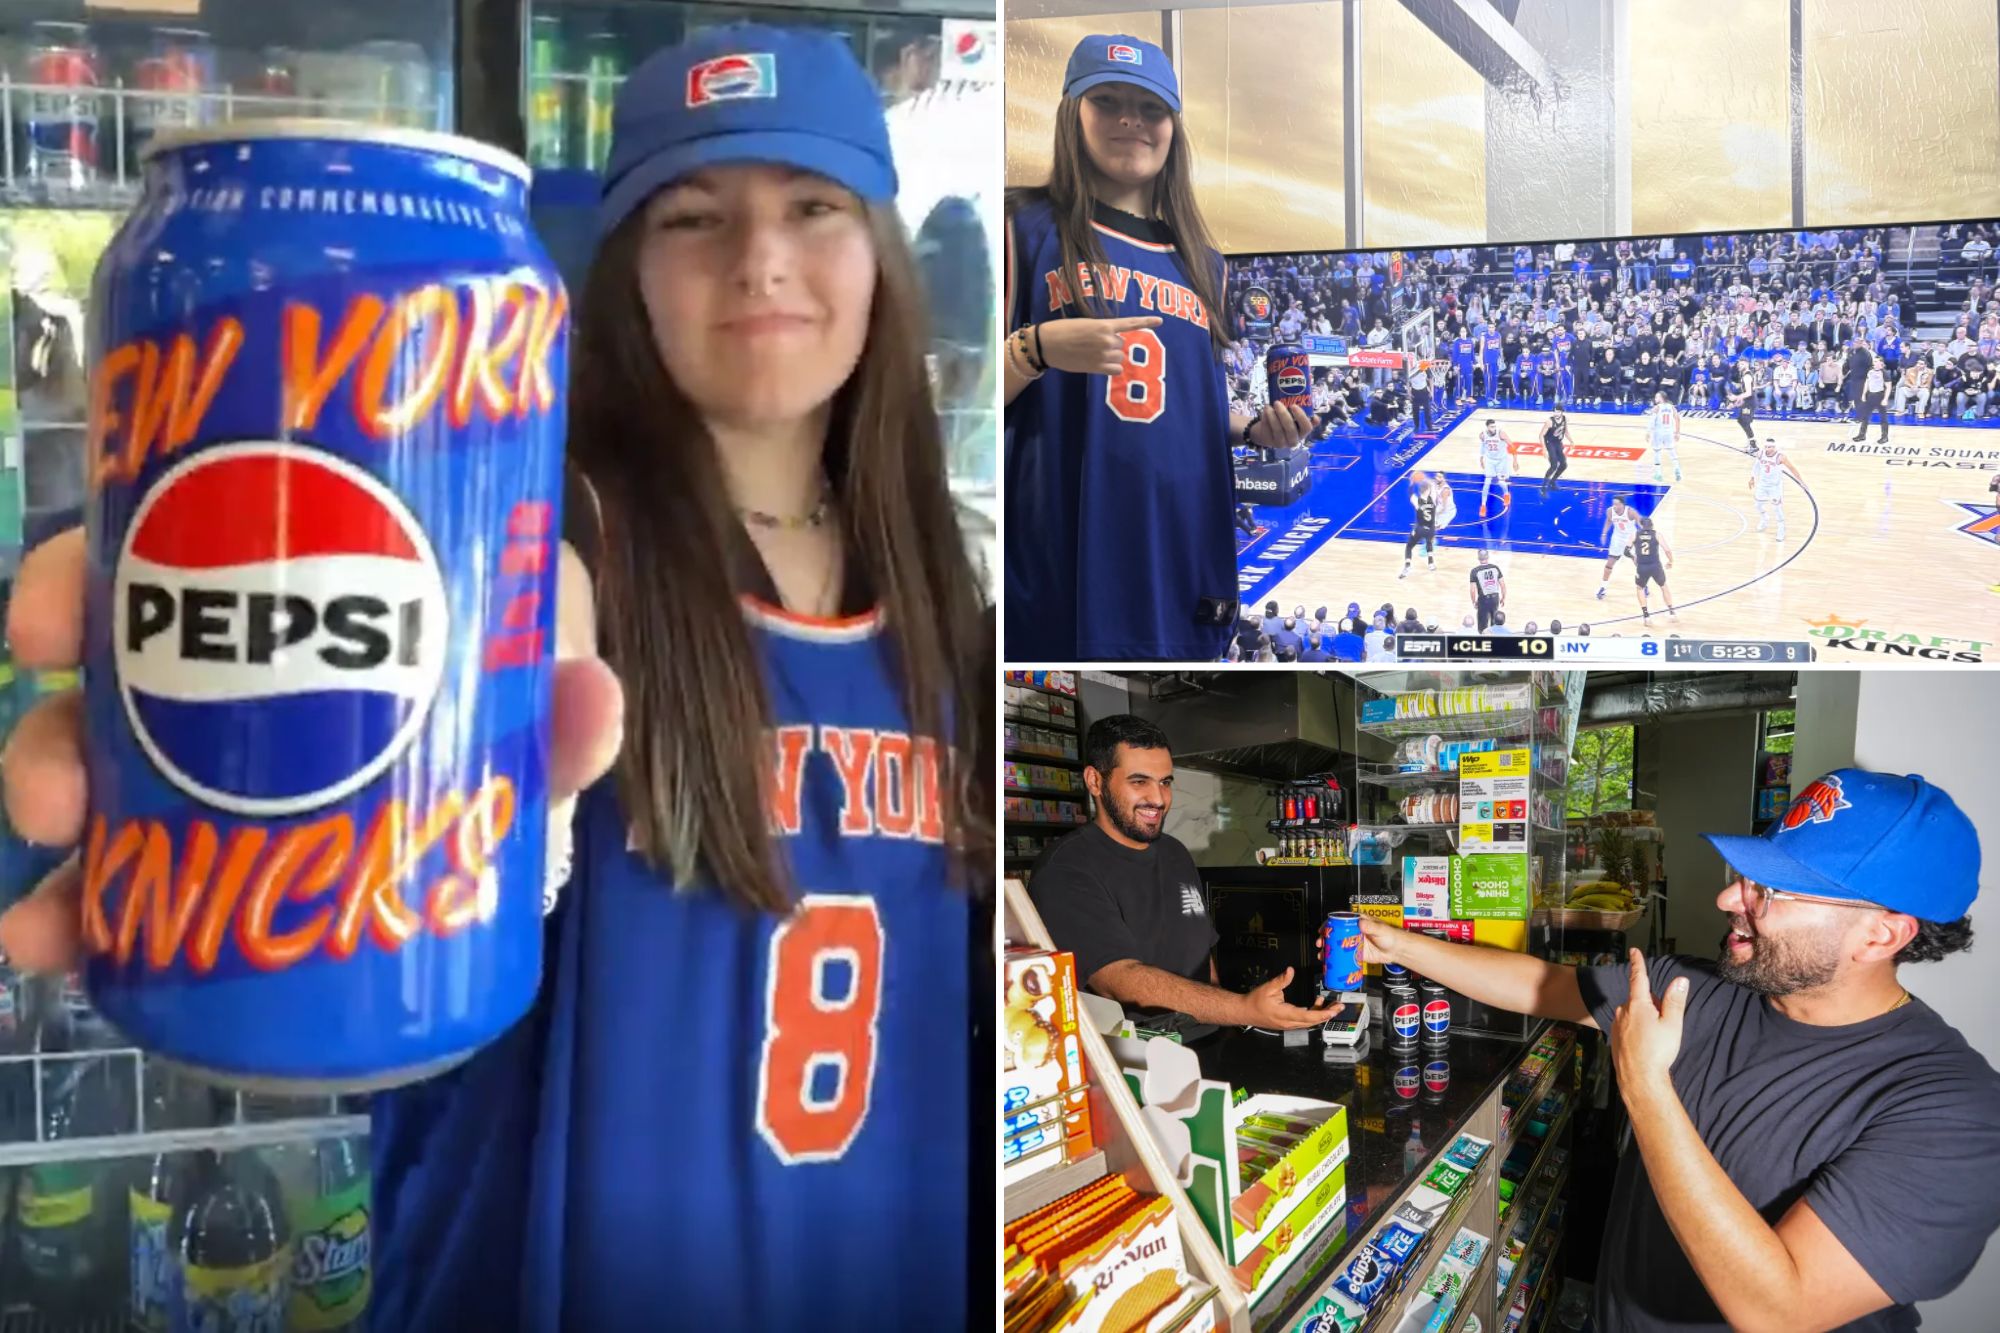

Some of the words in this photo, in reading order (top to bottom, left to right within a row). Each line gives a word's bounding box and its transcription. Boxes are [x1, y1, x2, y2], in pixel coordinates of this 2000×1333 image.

[89, 316, 245, 490] EW
[283, 281, 566, 442] YORK
[1105, 327, 1166, 423] 8
[1827, 442, 1921, 456] MADISON
[1929, 447, 2000, 459] SQUAR
[1886, 458, 2000, 470] CHASE
[1238, 565, 1275, 591] ORK
[1258, 517, 1332, 561] KNICKS
[127, 582, 423, 671] PEPSI
[1808, 625, 1993, 653] DRAFT
[1403, 640, 1441, 652] ESPN
[1459, 641, 1492, 652] CLE
[1518, 639, 1548, 654] 10
[1567, 642, 1590, 654] NY
[1641, 642, 1659, 656] 8
[1711, 645, 1762, 660] 5:23
[1786, 646, 1796, 660] 9
[1825, 638, 1983, 664] KINGS
[82, 775, 516, 973] KNICKS
[1453, 858, 1463, 916] CHOCOVIP
[756, 893, 884, 1165] 8
[1441, 1171, 1460, 1189] ICE
[1390, 1232, 1416, 1258] ICE
[1348, 1246, 1375, 1295] eclipse
